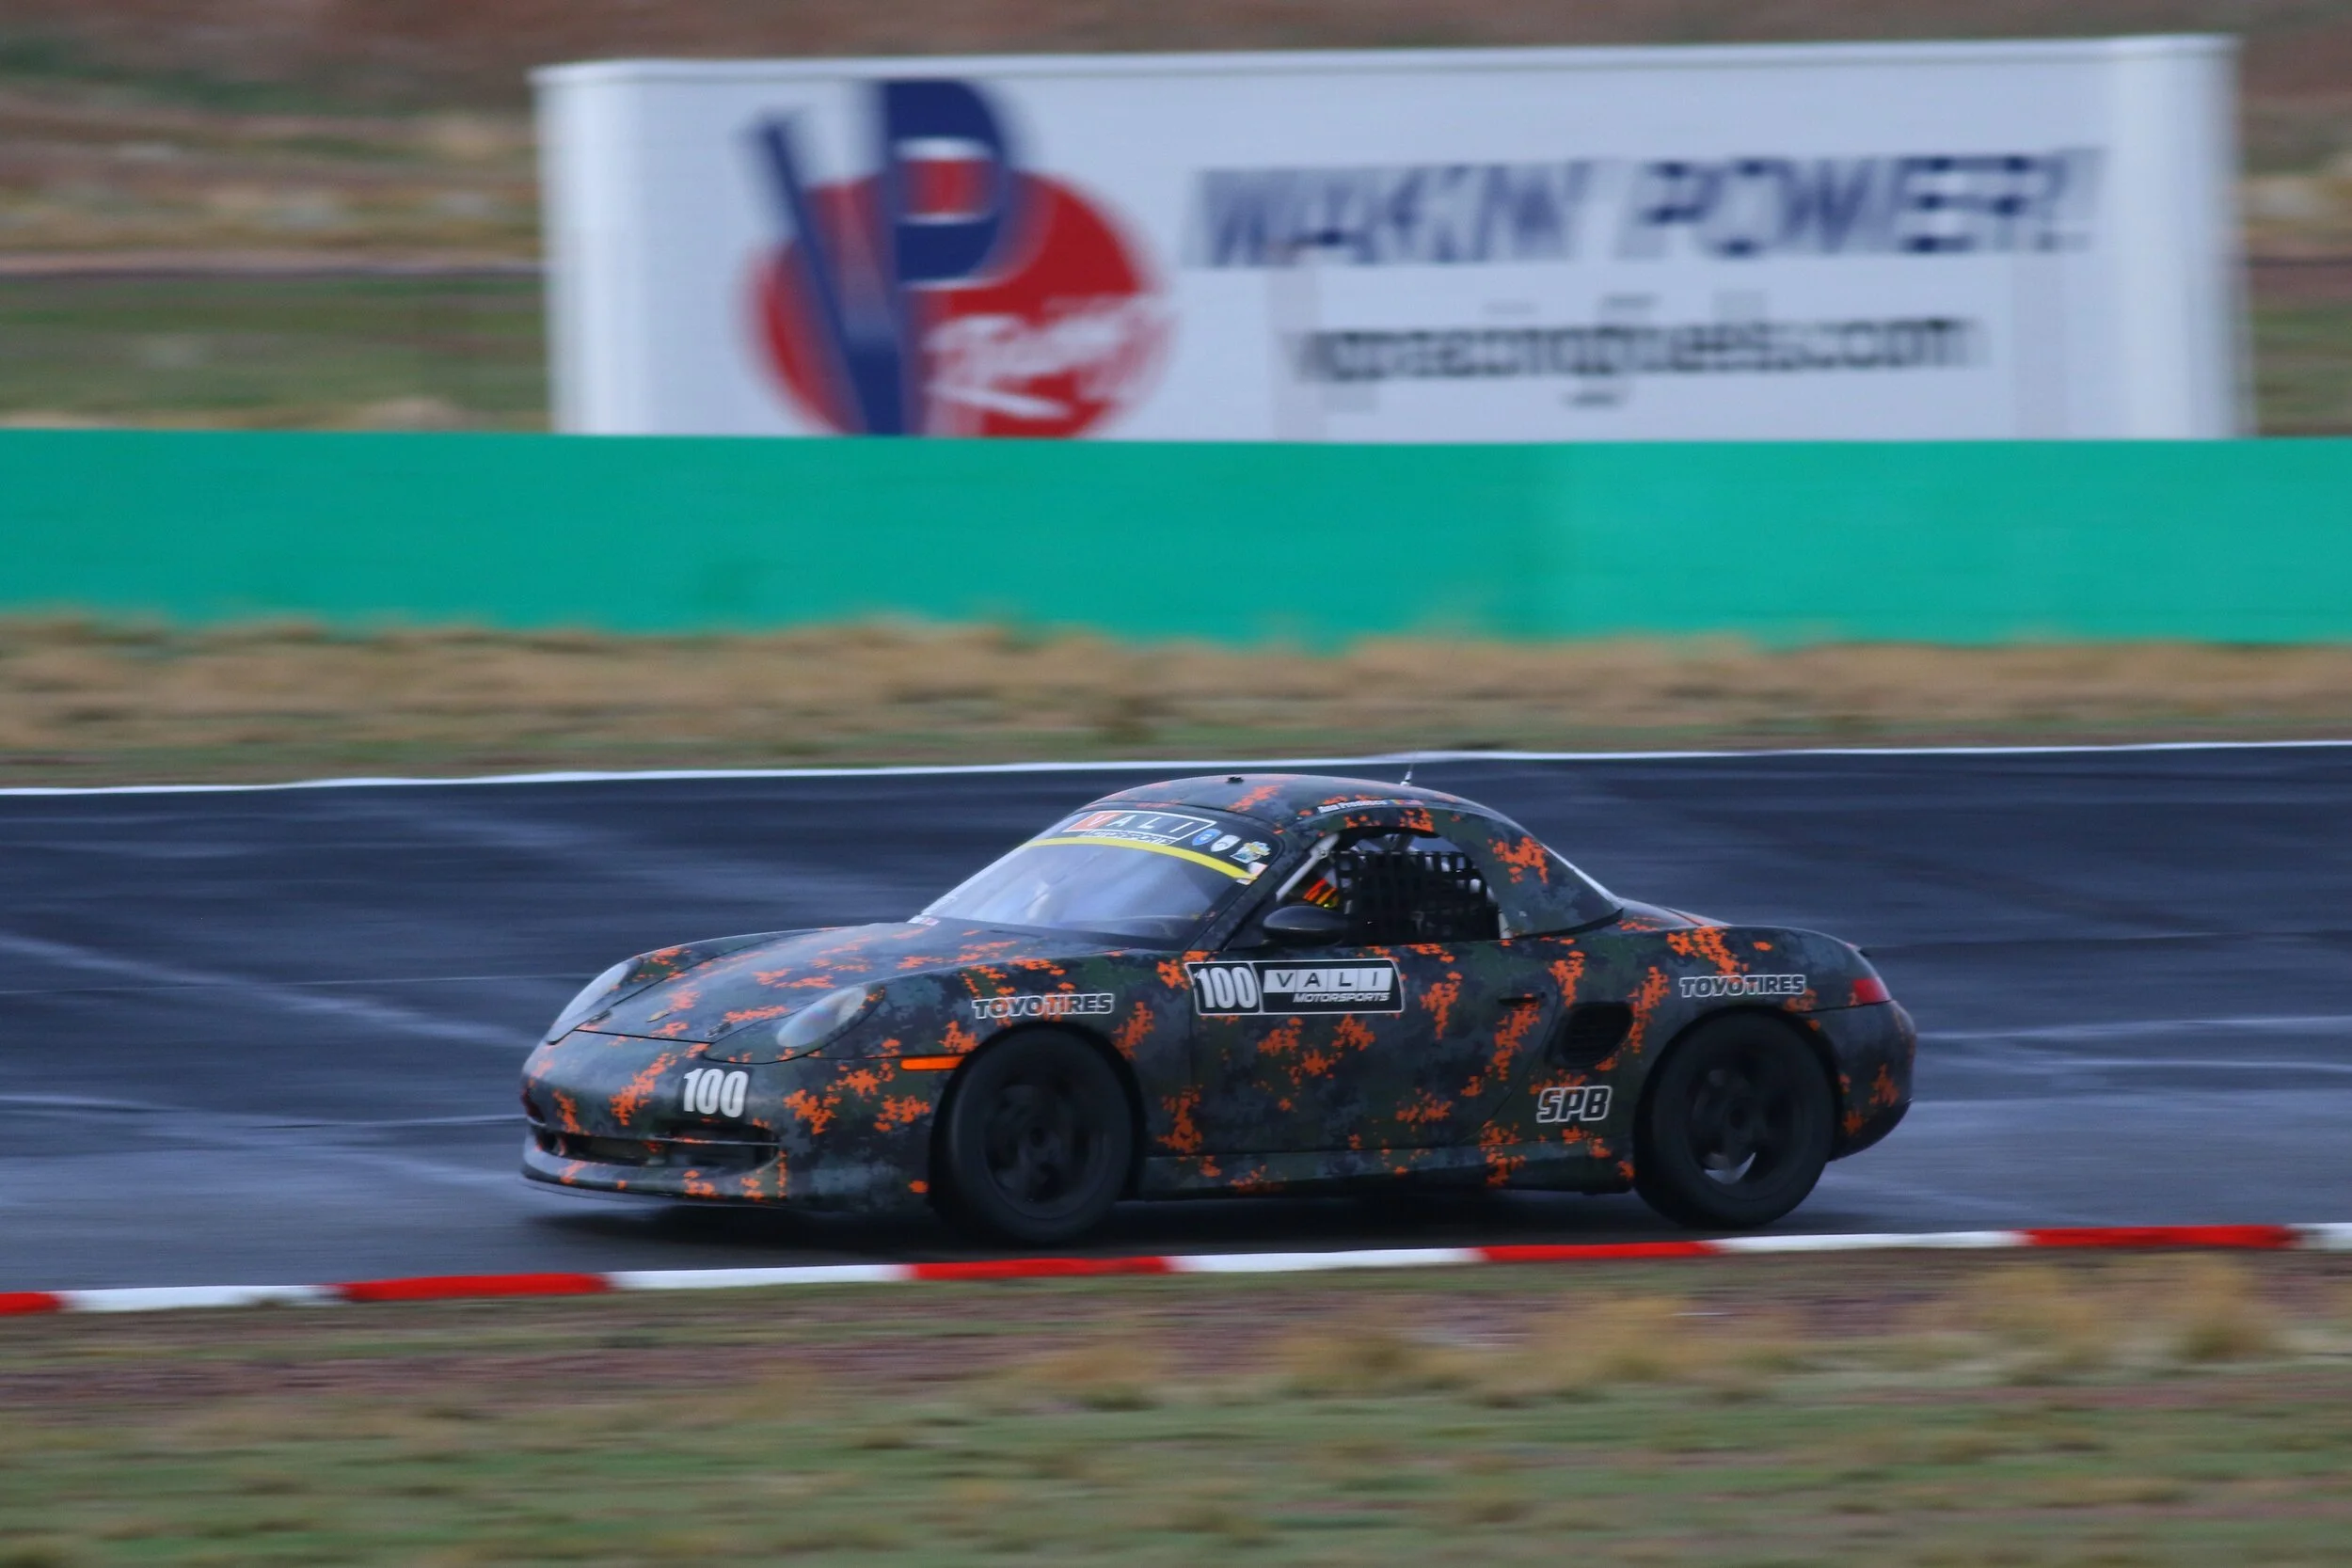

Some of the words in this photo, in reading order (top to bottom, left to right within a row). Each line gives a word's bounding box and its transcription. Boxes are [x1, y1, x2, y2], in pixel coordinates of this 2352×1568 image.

[1194, 967, 1258, 1008] 100
[1276, 971, 1378, 988] VALI
[1293, 992, 1391, 1003] MOTORSPORTS
[683, 1068, 750, 1118] 100
[1536, 1085, 1613, 1123] SPB
